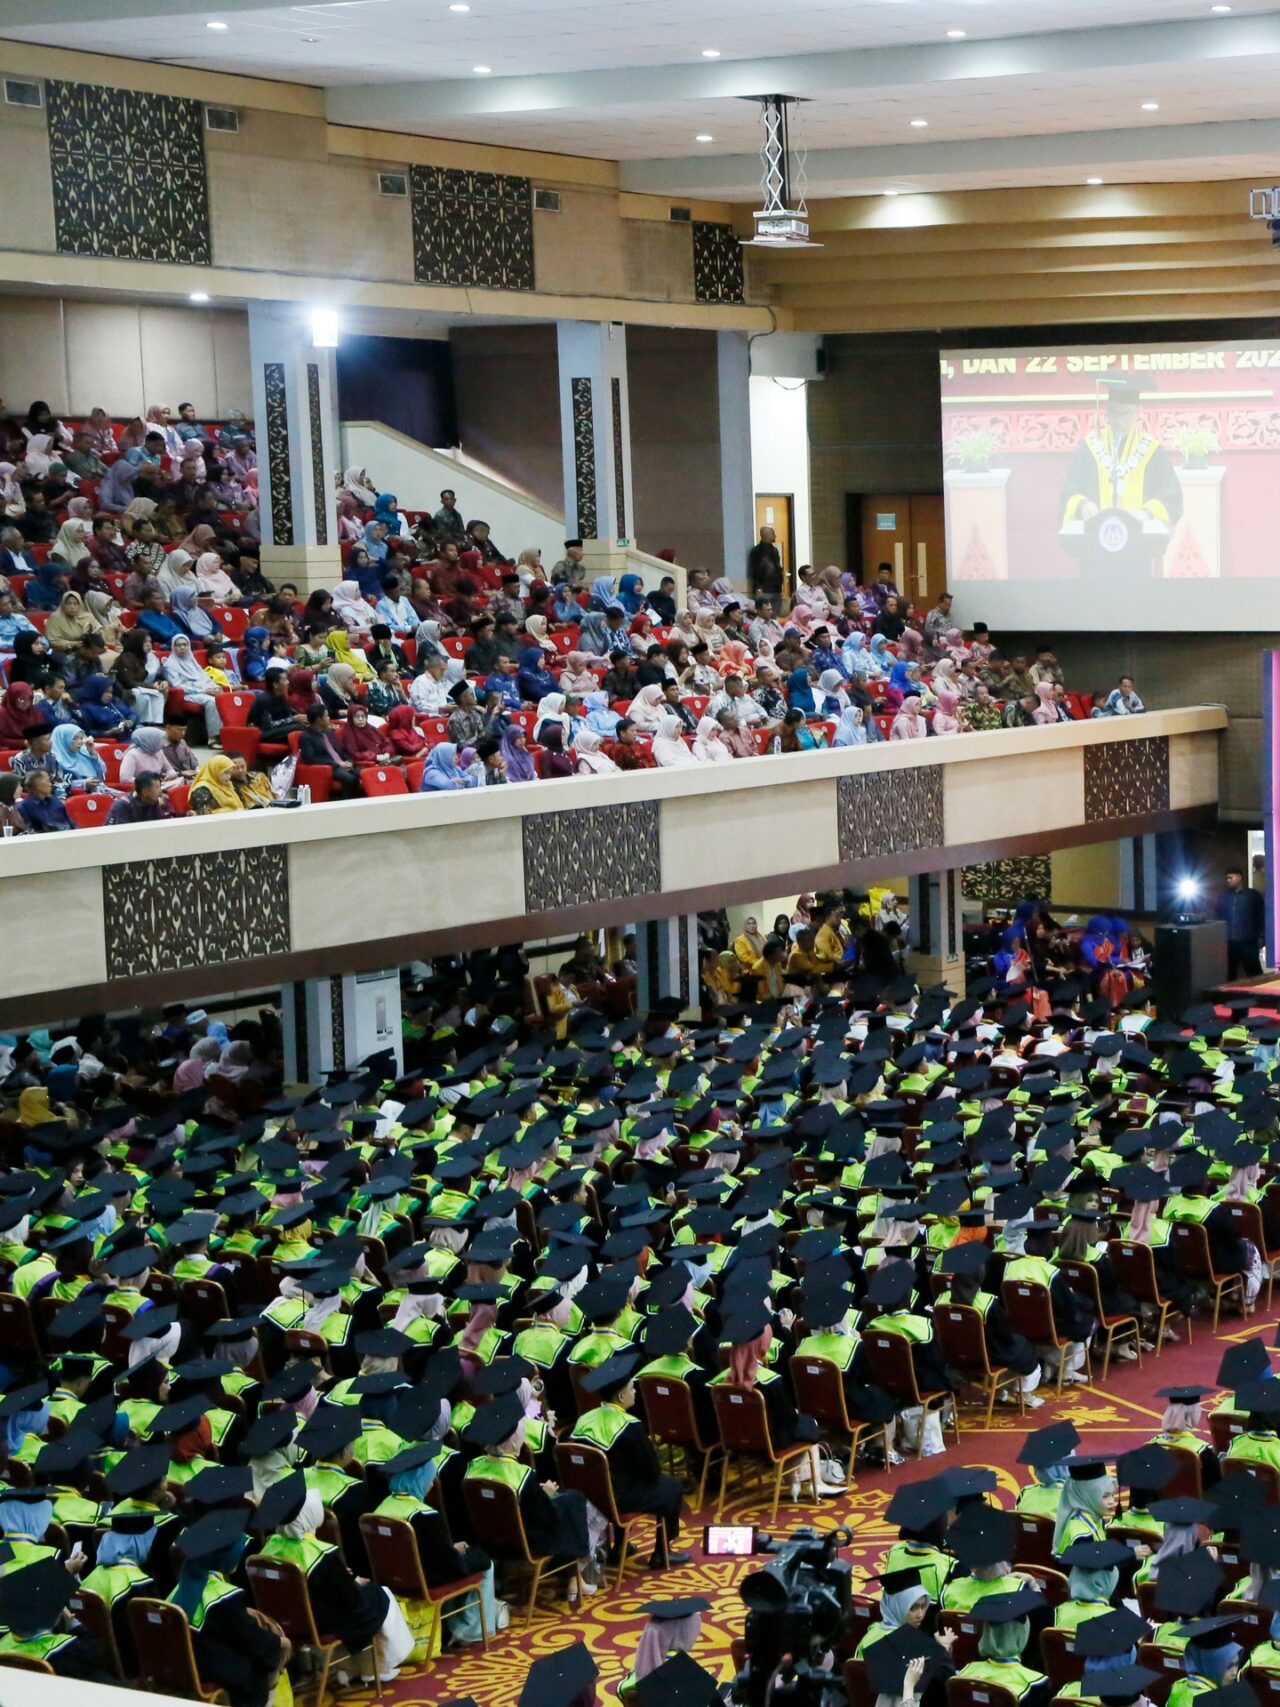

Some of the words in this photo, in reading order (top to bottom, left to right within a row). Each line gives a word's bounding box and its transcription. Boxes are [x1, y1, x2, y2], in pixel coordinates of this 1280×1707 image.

[963, 358, 1016, 374] DAN
[1026, 357, 1057, 373] 22
[1067, 352, 1225, 372] SEPTEMBER
